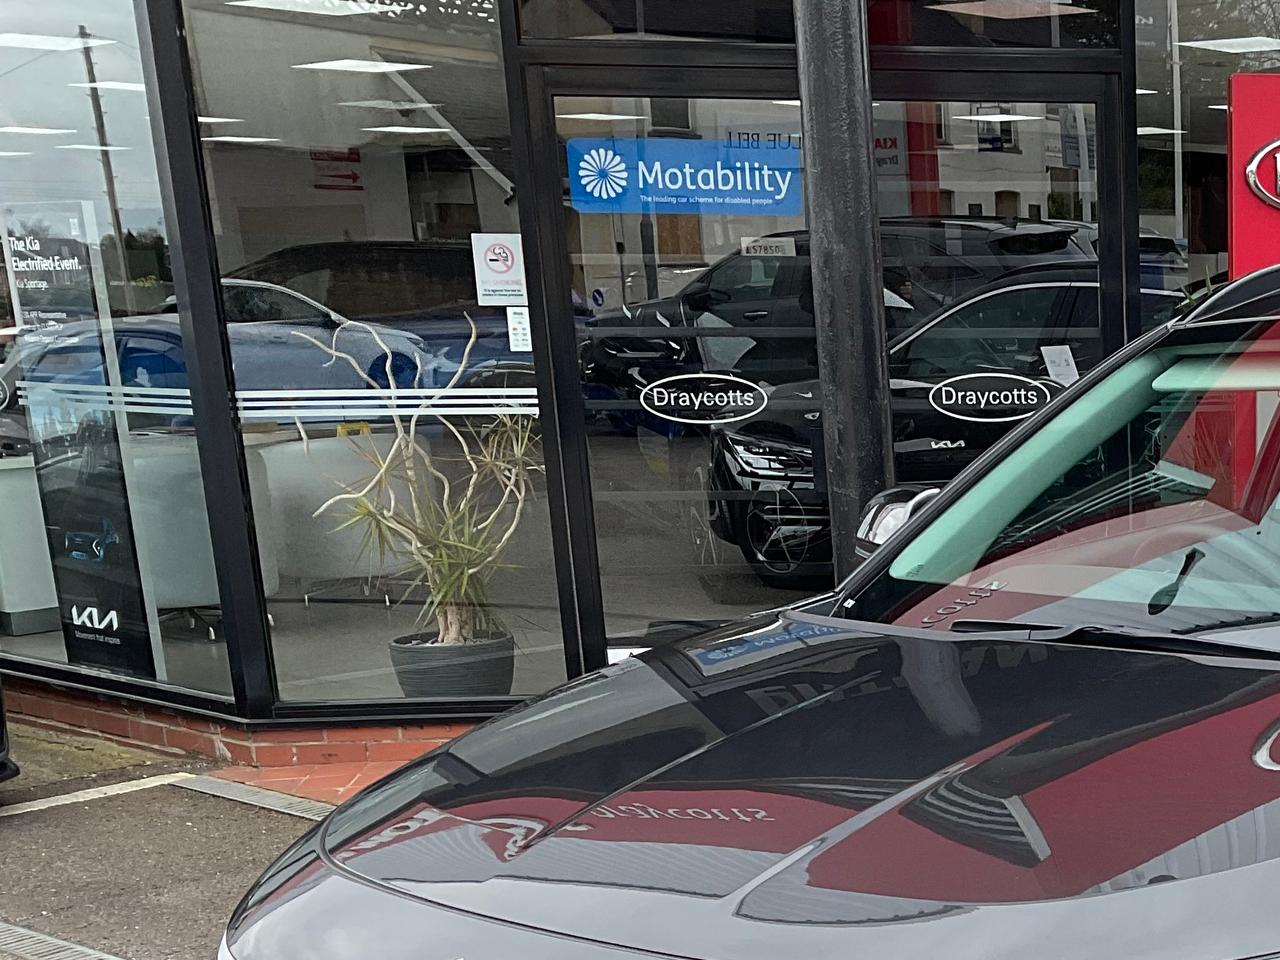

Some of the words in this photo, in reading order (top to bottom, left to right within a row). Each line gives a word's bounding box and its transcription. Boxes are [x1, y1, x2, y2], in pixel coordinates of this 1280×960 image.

[638, 160, 791, 200] Motability
[653, 196, 676, 204] leading
[8, 237, 25, 251] The
[25, 236, 40, 251] Kia
[12, 257, 53, 271] Electrified
[53, 256, 82, 270] Event.
[652, 388, 755, 410] Draycotts
[941, 386, 1038, 408] Draycotts
[931, 440, 966, 449] KIA
[71, 604, 119, 631] KIA
